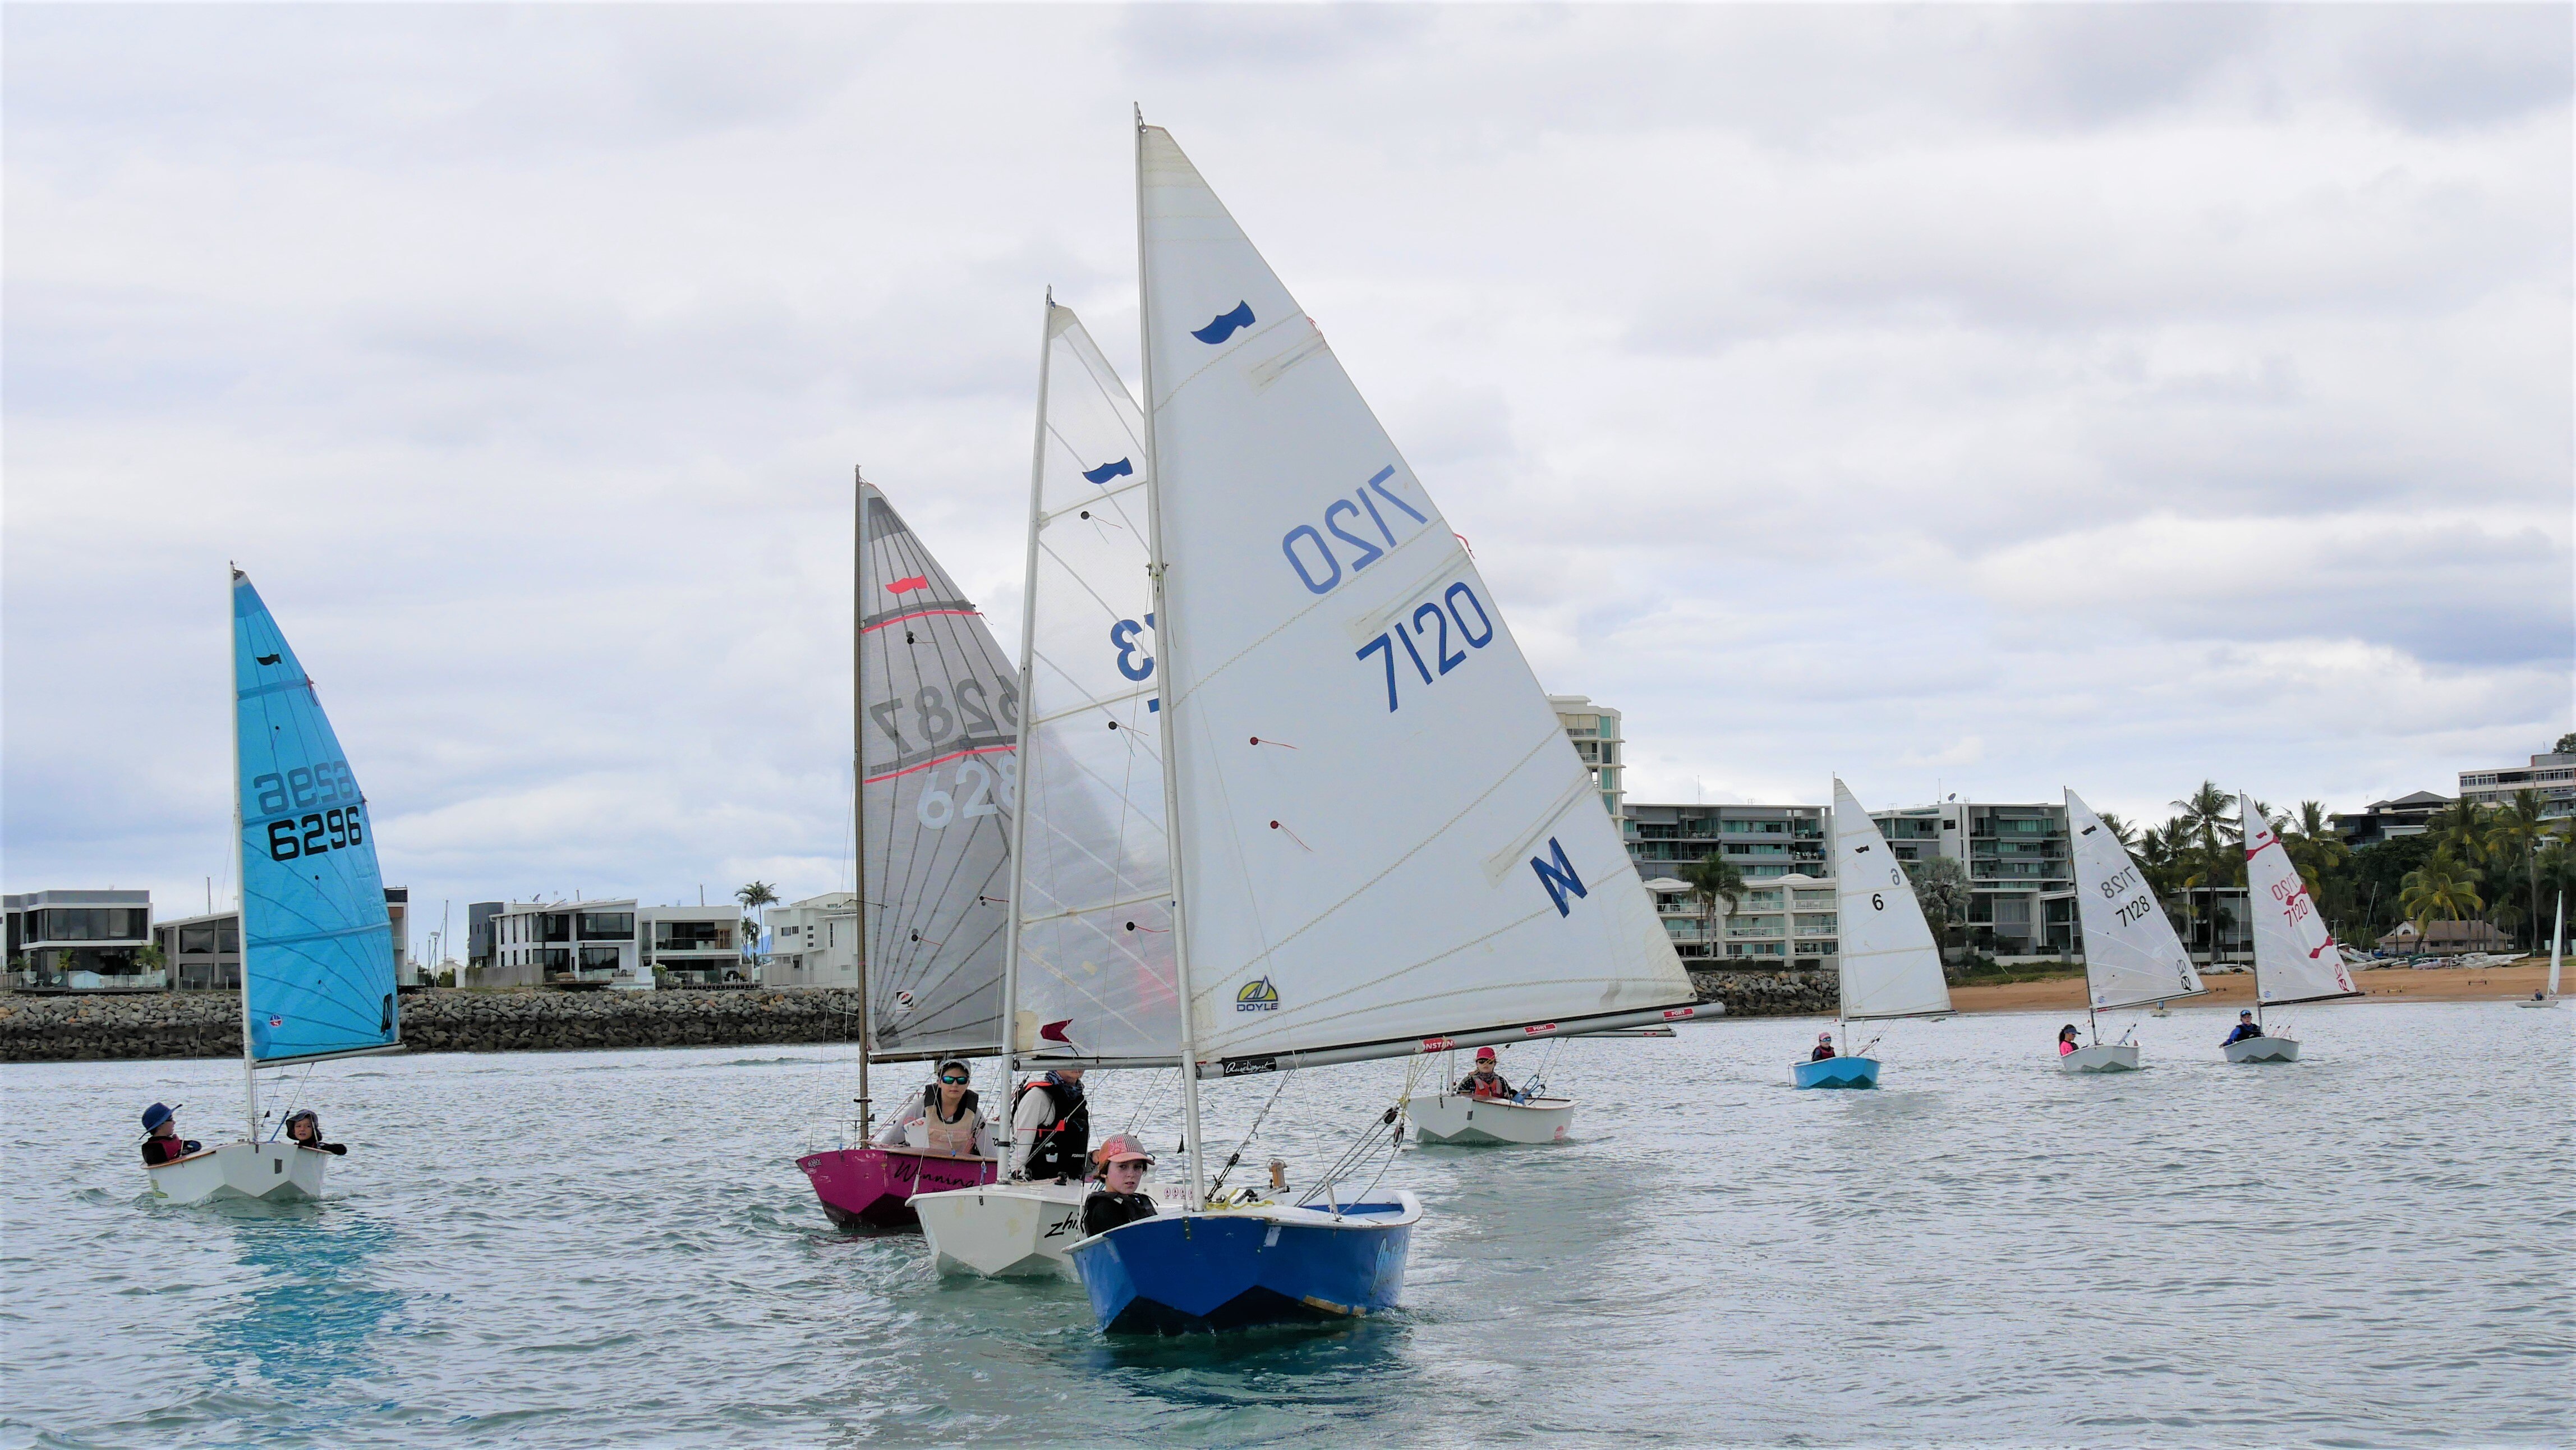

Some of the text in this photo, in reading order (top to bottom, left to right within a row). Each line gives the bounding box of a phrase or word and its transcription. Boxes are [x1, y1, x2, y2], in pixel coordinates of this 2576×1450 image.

[1355, 581, 1493, 713] 7120
[917, 755, 1016, 830] 628
[268, 806, 362, 861] 6296
[1530, 836, 1588, 919] N
[1872, 893, 1884, 911] 6
[2115, 896, 2150, 927] 7128
[2283, 899, 2308, 927] 7120
[1237, 1003, 1278, 1011] DOYLE
[894, 1161, 975, 1187] Wnning
